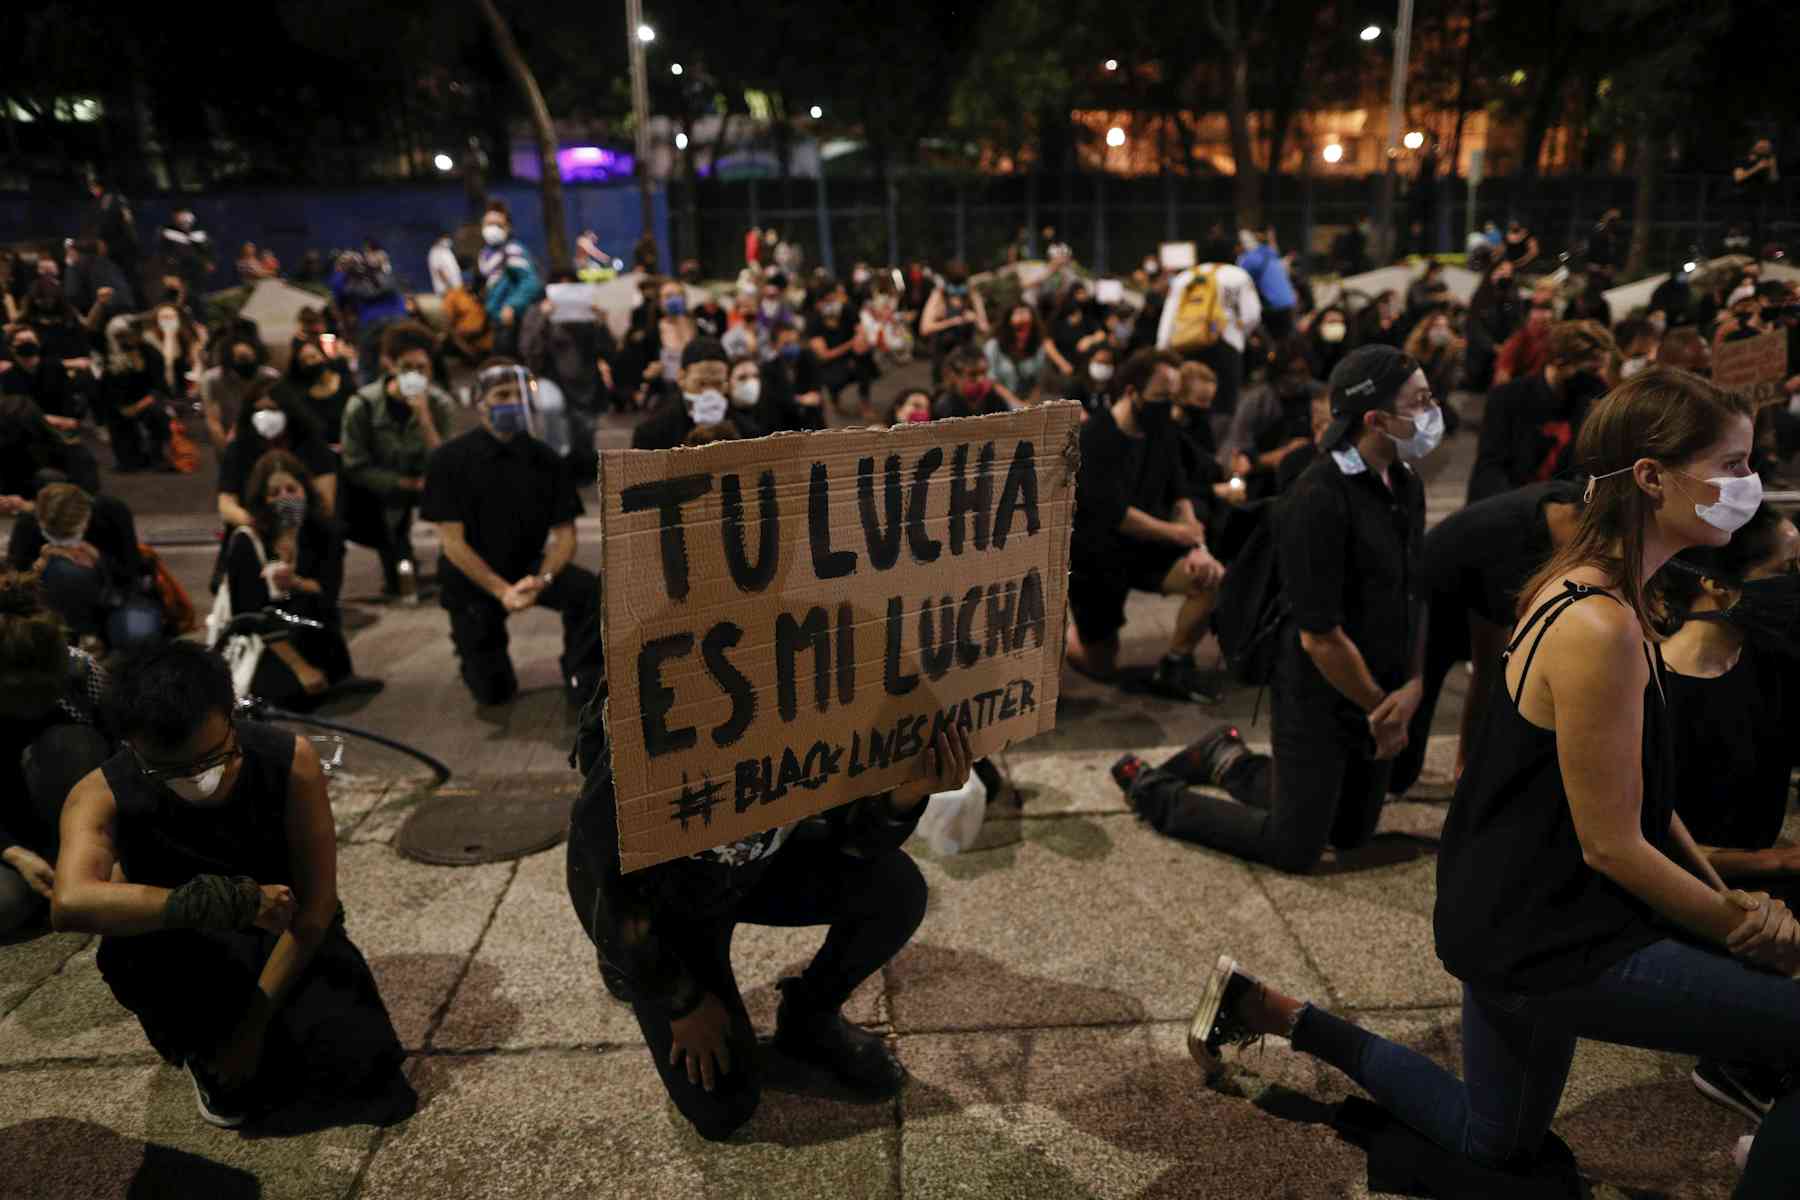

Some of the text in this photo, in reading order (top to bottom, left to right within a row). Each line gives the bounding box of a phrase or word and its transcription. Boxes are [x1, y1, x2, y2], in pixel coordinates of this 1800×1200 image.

[622, 440, 1041, 603] TU LUCHA
[638, 567, 1045, 760] ES MI LUCHA
